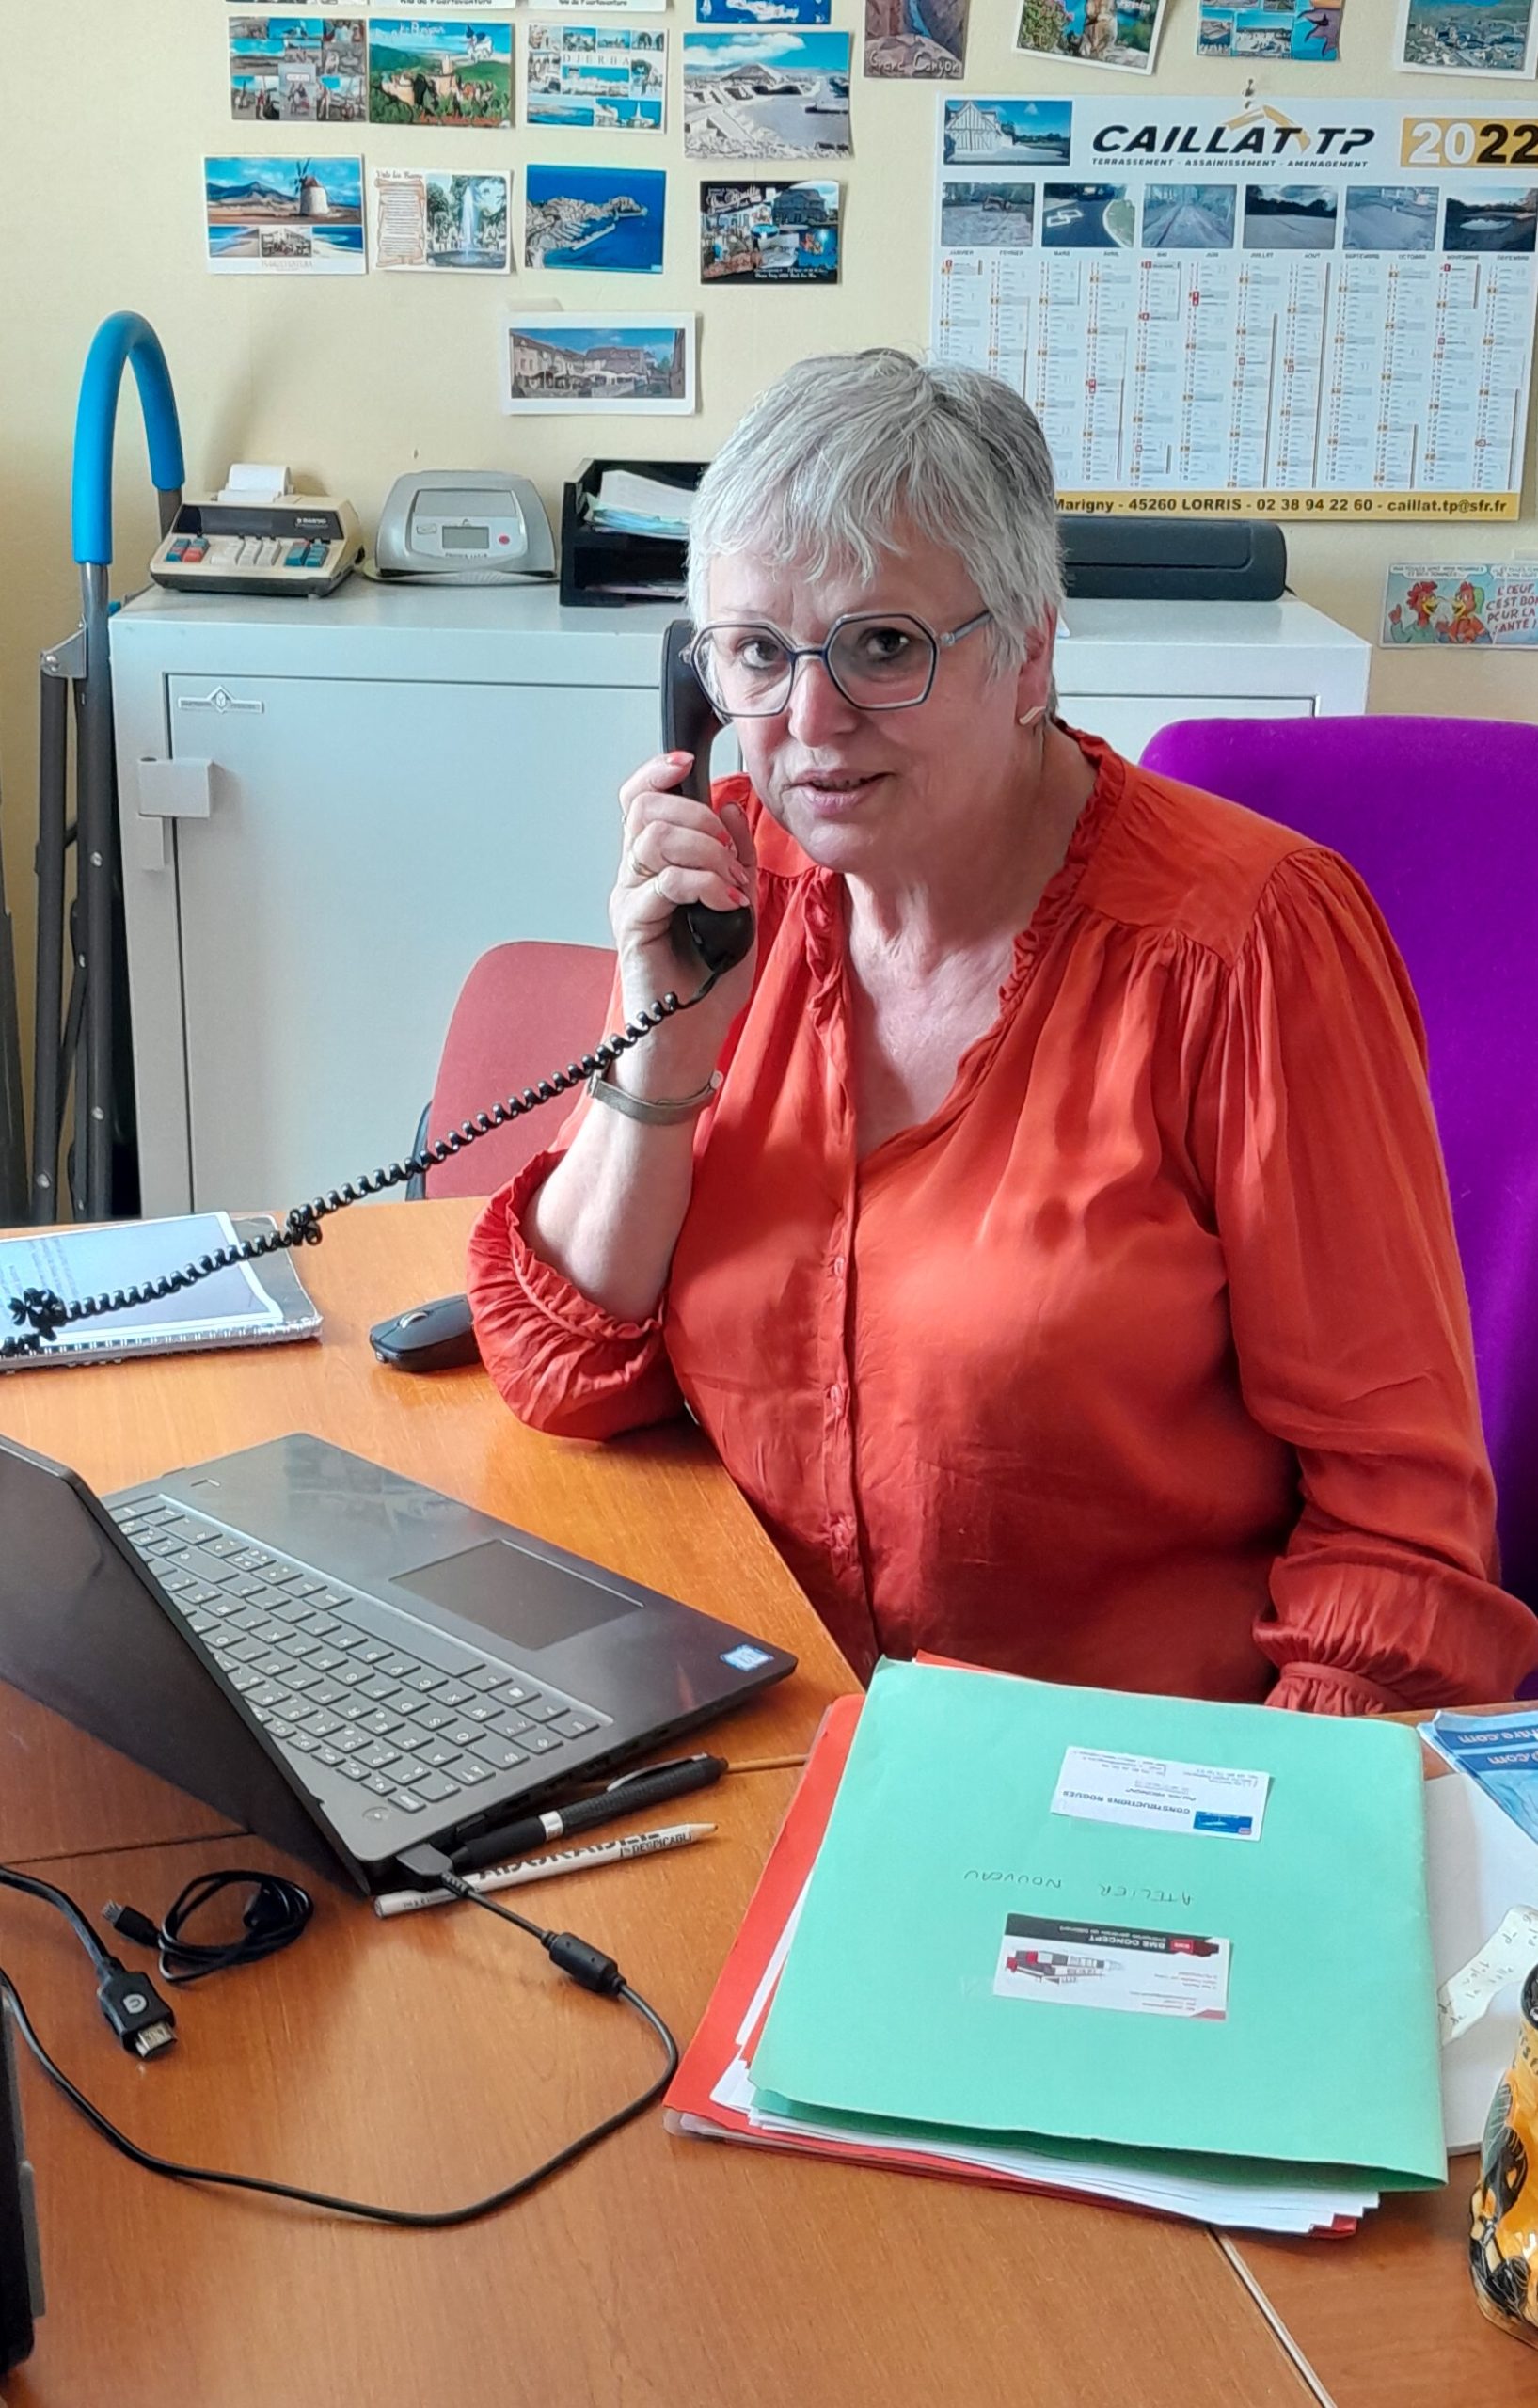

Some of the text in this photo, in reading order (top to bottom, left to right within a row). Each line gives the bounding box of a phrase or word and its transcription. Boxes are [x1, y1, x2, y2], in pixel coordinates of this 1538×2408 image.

[913, 51, 961, 77] Canyon
[1092, 124, 1375, 155] CAILLAT TP
[1409, 122, 1538, 164] 2022
[1091, 158, 1175, 166] TERRASSEMENT
[1286, 159, 1368, 168] AMENAGEMENT
[1129, 499, 1177, 511] 45260
[1182, 499, 1242, 511] LORRIS
[1256, 499, 1276, 511] 02
[1281, 499, 1300, 511] 38
[1306, 499, 1324, 511] 94
[1328, 499, 1348, 511] 22
[1354, 499, 1372, 511] 60
[1387, 499, 1506, 515] caillat.tp@sfr.fr
[963, 1870, 1192, 1906] ATELIER NOUVEAU
[1088, 1934, 1139, 1947] CONCEPT
